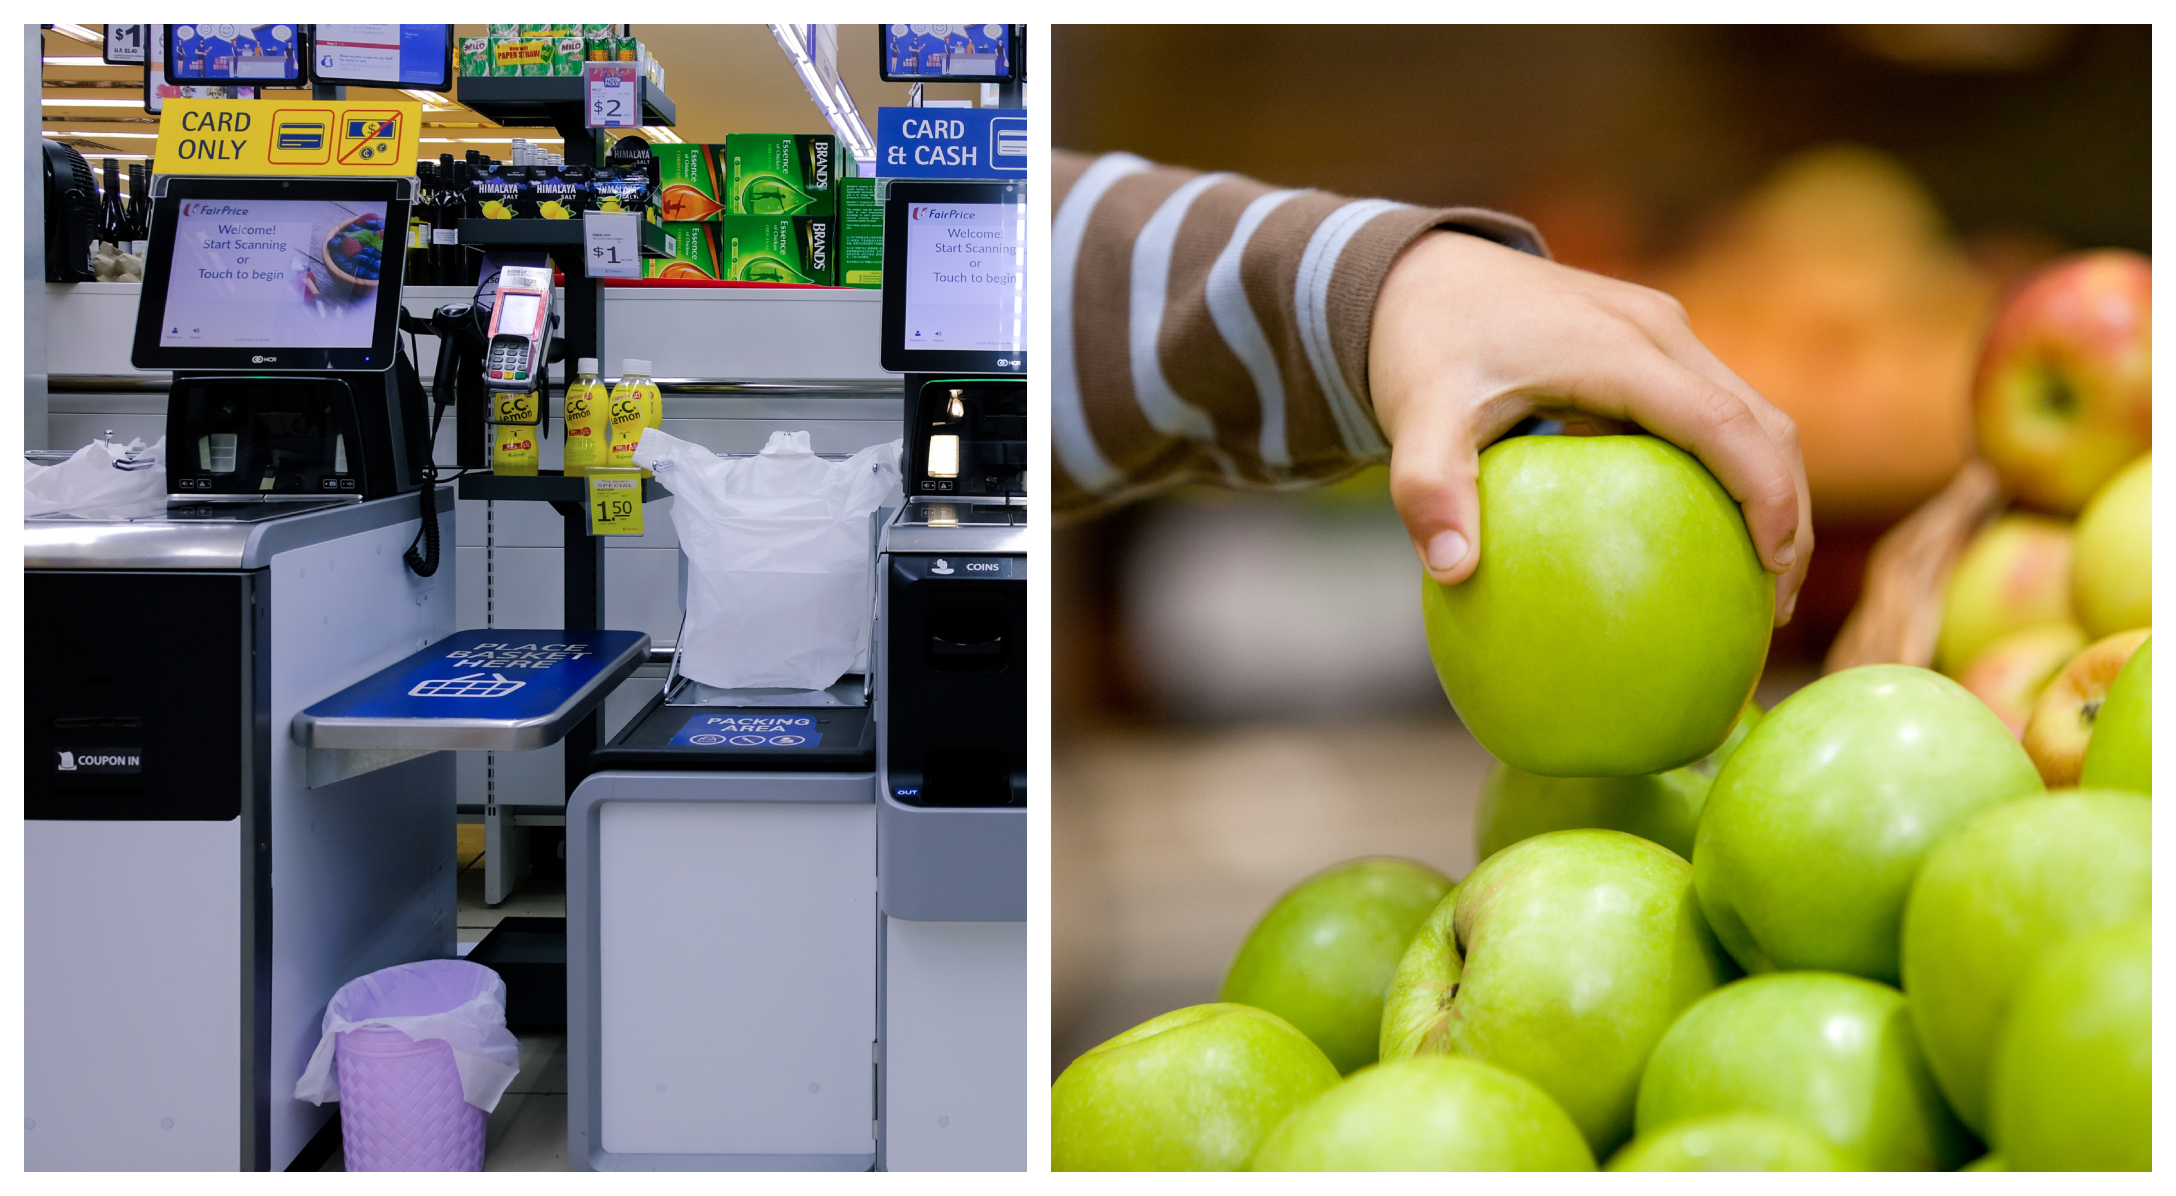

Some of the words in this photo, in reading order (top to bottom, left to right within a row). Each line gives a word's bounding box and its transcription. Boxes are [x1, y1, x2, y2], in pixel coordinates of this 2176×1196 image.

[464, 42, 485, 52] MILO
[561, 42, 581, 51] MILO
[518, 50, 540, 58] STRAW
[182, 111, 251, 132] CARD
[902, 119, 965, 139] CARD
[178, 139, 247, 160] ONLY
[614, 150, 650, 159] HIMALAYA
[782, 139, 791, 174] Essence
[888, 146, 907, 165] &
[914, 145, 977, 166] CASH
[478, 184, 518, 194] HIMALAYA
[536, 184, 576, 194] HIMALAYA
[200, 205, 249, 216] FairPrice
[929, 209, 976, 219] FairPrice
[218, 224, 276, 234] Welcome!
[947, 228, 1004, 239] Welcome!
[780, 220, 788, 255] Essence
[203, 239, 231, 249] Start
[234, 240, 287, 252] Scanning
[935, 243, 962, 253] Start
[965, 243, 1016, 256] Scanning
[236, 256, 250, 264] or
[969, 260, 982, 268] or
[198, 268, 233, 279] Touch
[236, 270, 248, 279] to
[252, 269, 284, 282] begin
[933, 272, 967, 283] Touch
[971, 273, 983, 283] to
[986, 273, 1017, 285] begin
[501, 399, 529, 415] C.C.
[566, 400, 587, 414] C.C.
[611, 400, 636, 416] C.C.
[966, 563, 1000, 571] COINS
[473, 643, 589, 652] PLACE
[446, 650, 592, 660] BASKET
[453, 659, 558, 669] HERE
[706, 718, 810, 726] PACKING
[78, 755, 126, 766] COUPON
[128, 756, 139, 766] IN
